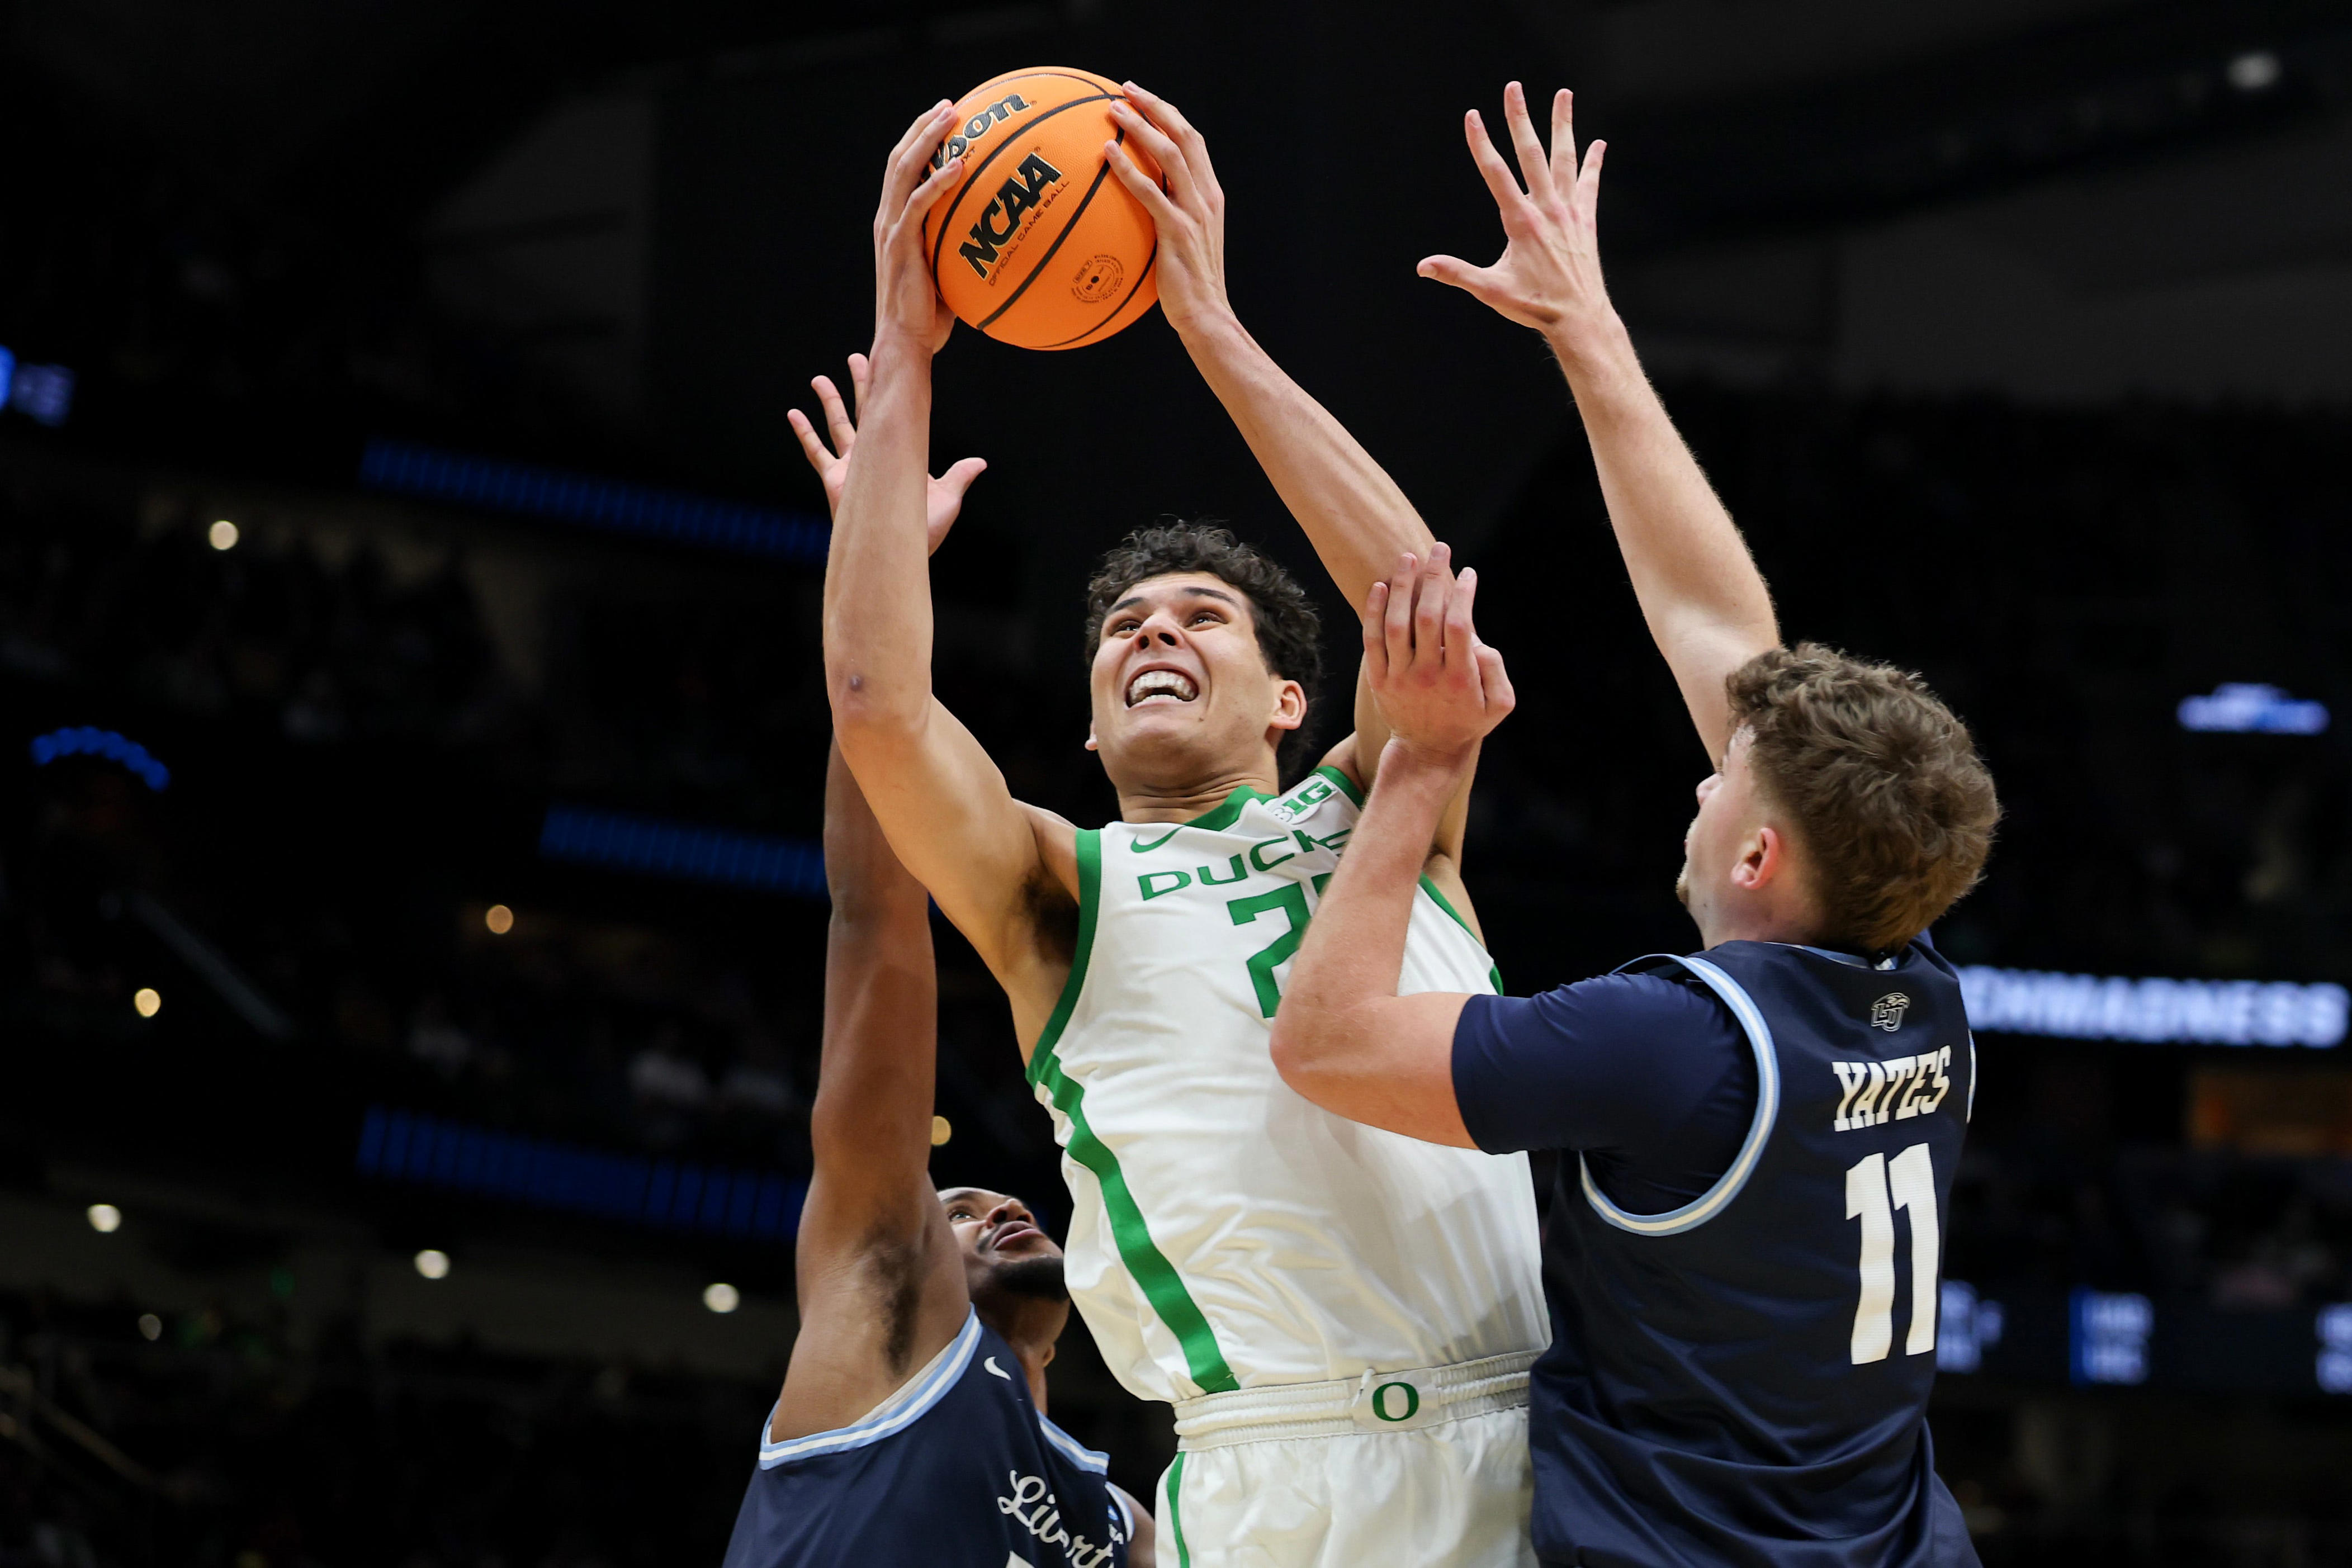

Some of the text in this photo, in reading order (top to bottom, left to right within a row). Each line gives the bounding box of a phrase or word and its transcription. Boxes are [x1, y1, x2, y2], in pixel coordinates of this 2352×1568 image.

[958, 151, 1063, 280] NCAA
[988, 181, 1069, 286] OFFICIAL GAME BALL
[1227, 872, 1333, 1019] 2
[1832, 1045, 1951, 1132] YATES
[1845, 1143, 1939, 1365] 11
[1372, 1381, 1419, 1422] O
